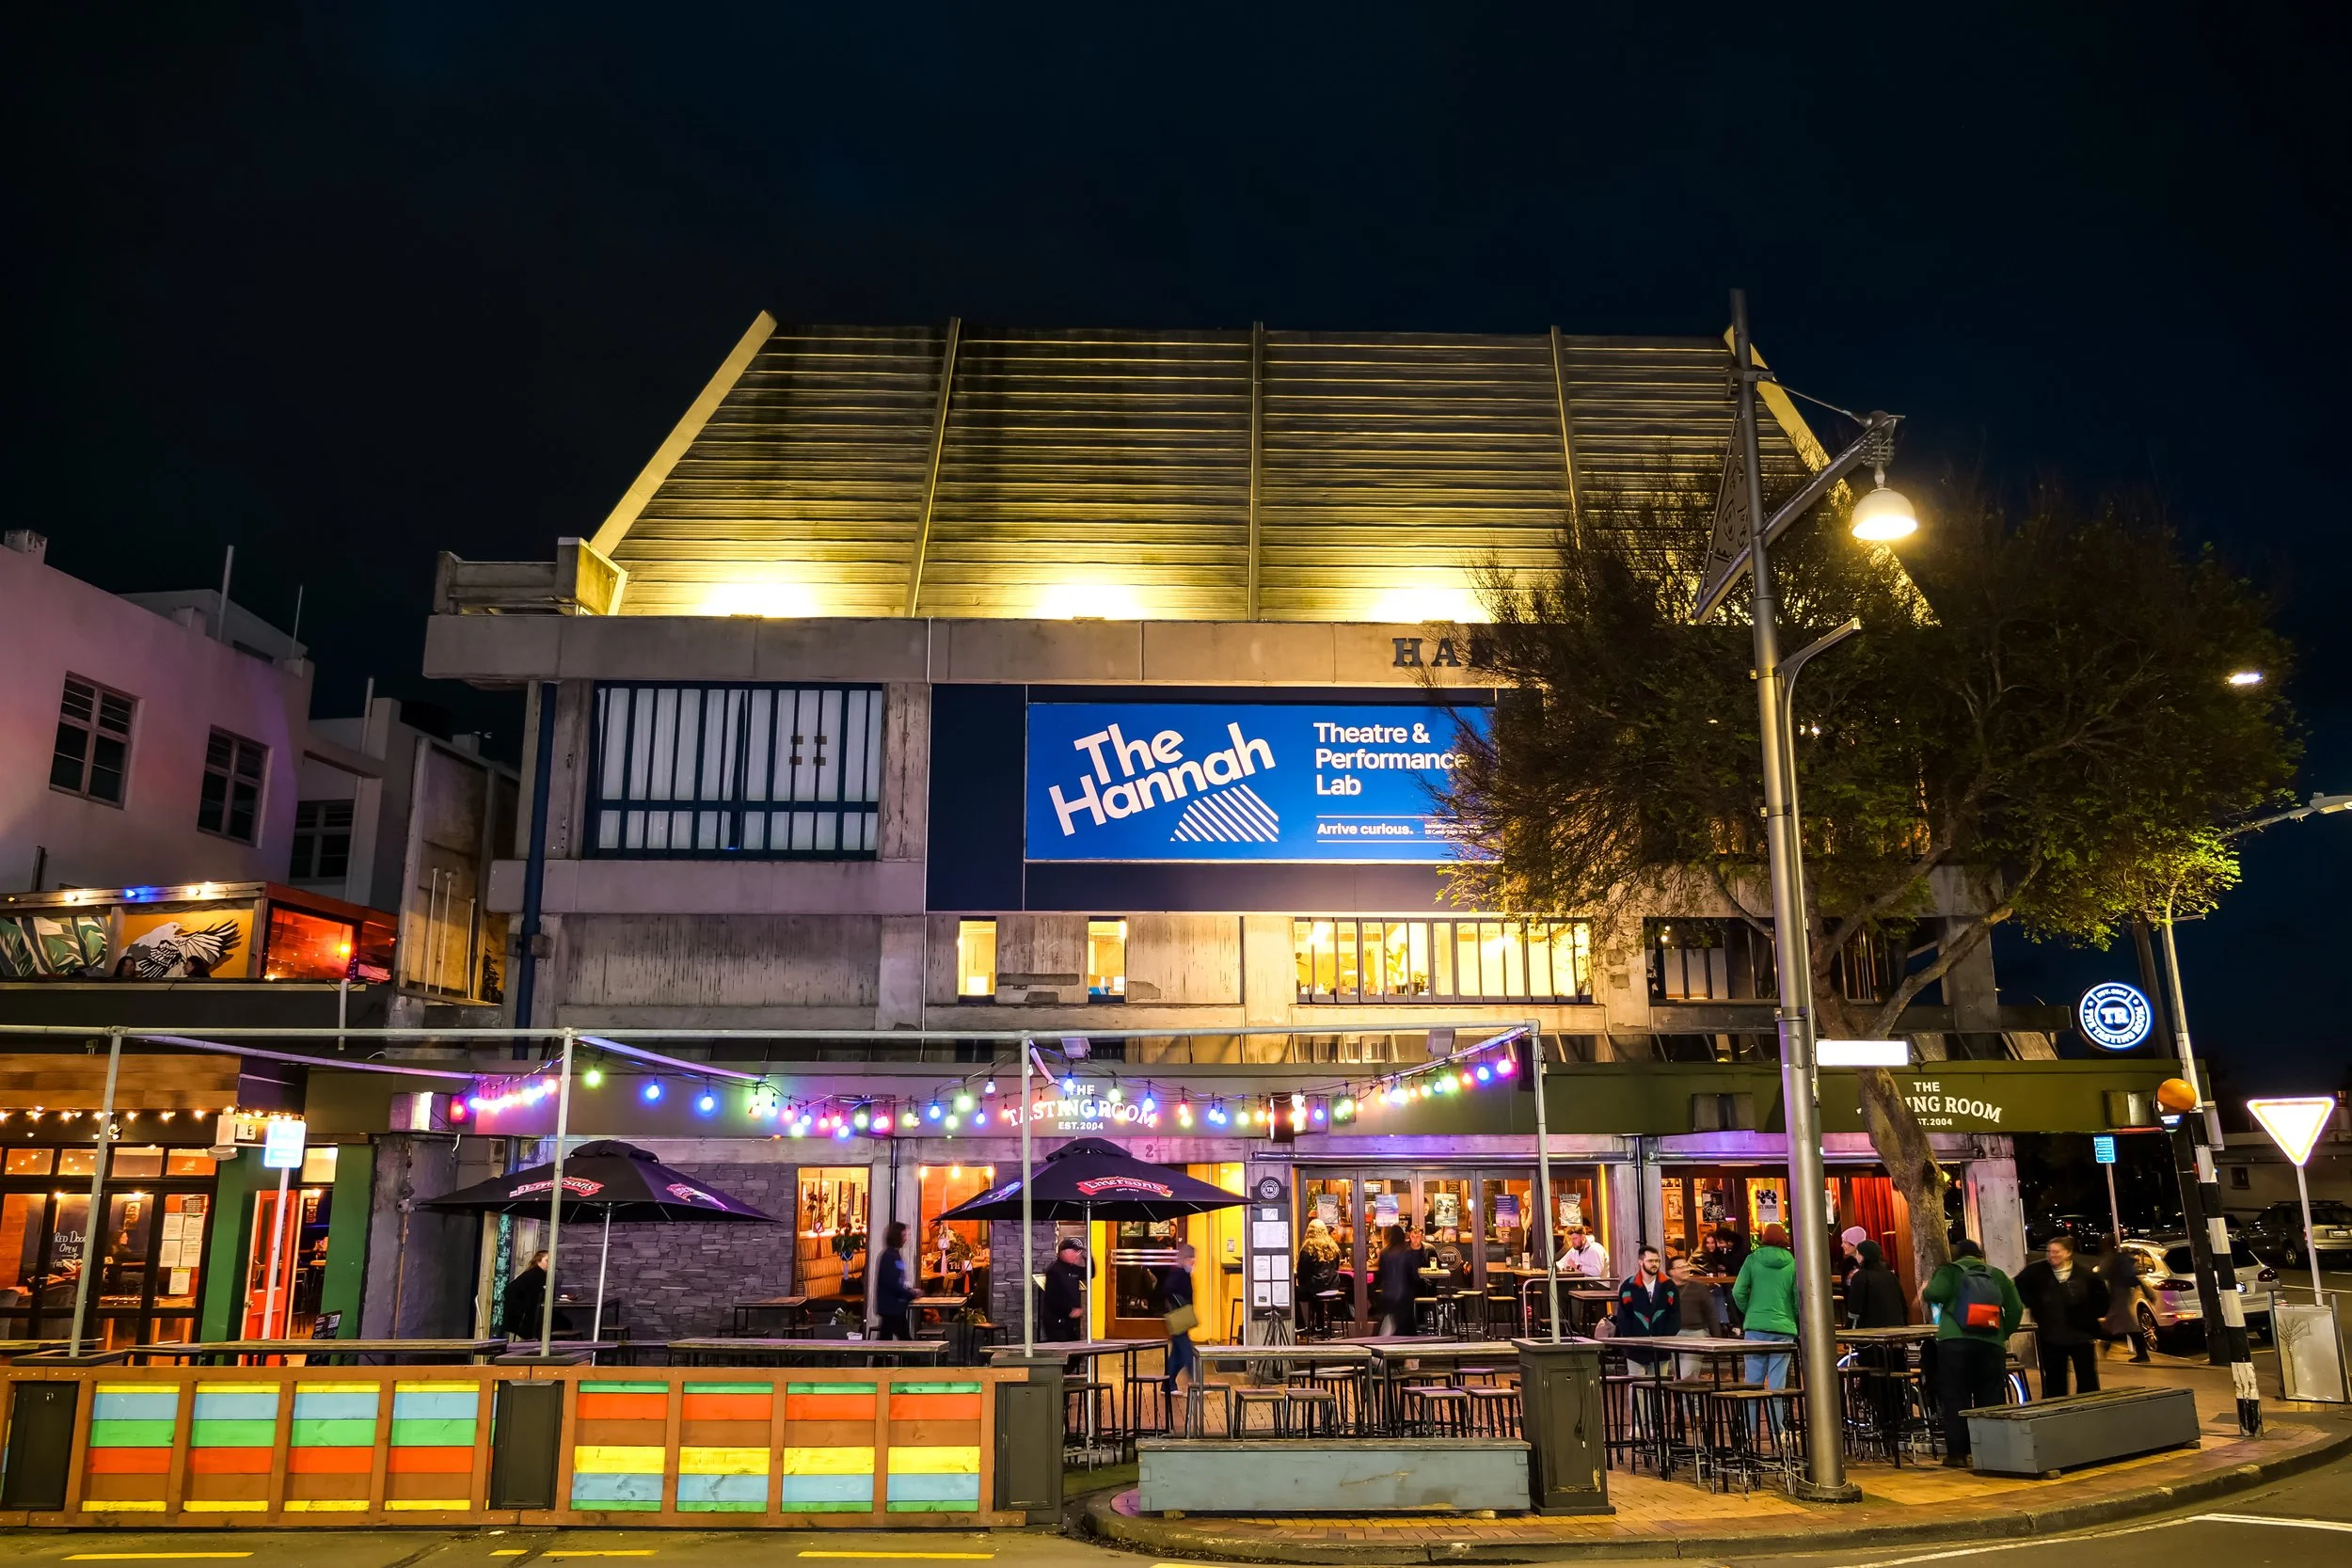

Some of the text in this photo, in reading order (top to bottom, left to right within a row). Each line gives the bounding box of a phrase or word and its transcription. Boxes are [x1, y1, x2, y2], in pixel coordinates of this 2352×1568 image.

[1313, 722, 1430, 744] Theatre &
[1073, 723, 1184, 784] The
[1316, 749, 1470, 769] Performance
[1049, 722, 1276, 836] Hannah
[1316, 775, 1361, 795] Lab
[1317, 823, 1358, 834] Arrive
[1360, 823, 1413, 834] curious.
[2100, 1006, 2130, 1024] TR
[1068, 1085, 1094, 1095] THE
[1914, 1082, 1940, 1092] THE
[1098, 1100, 1156, 1128] ROOM
[1945, 1096, 2002, 1123] ROOM
